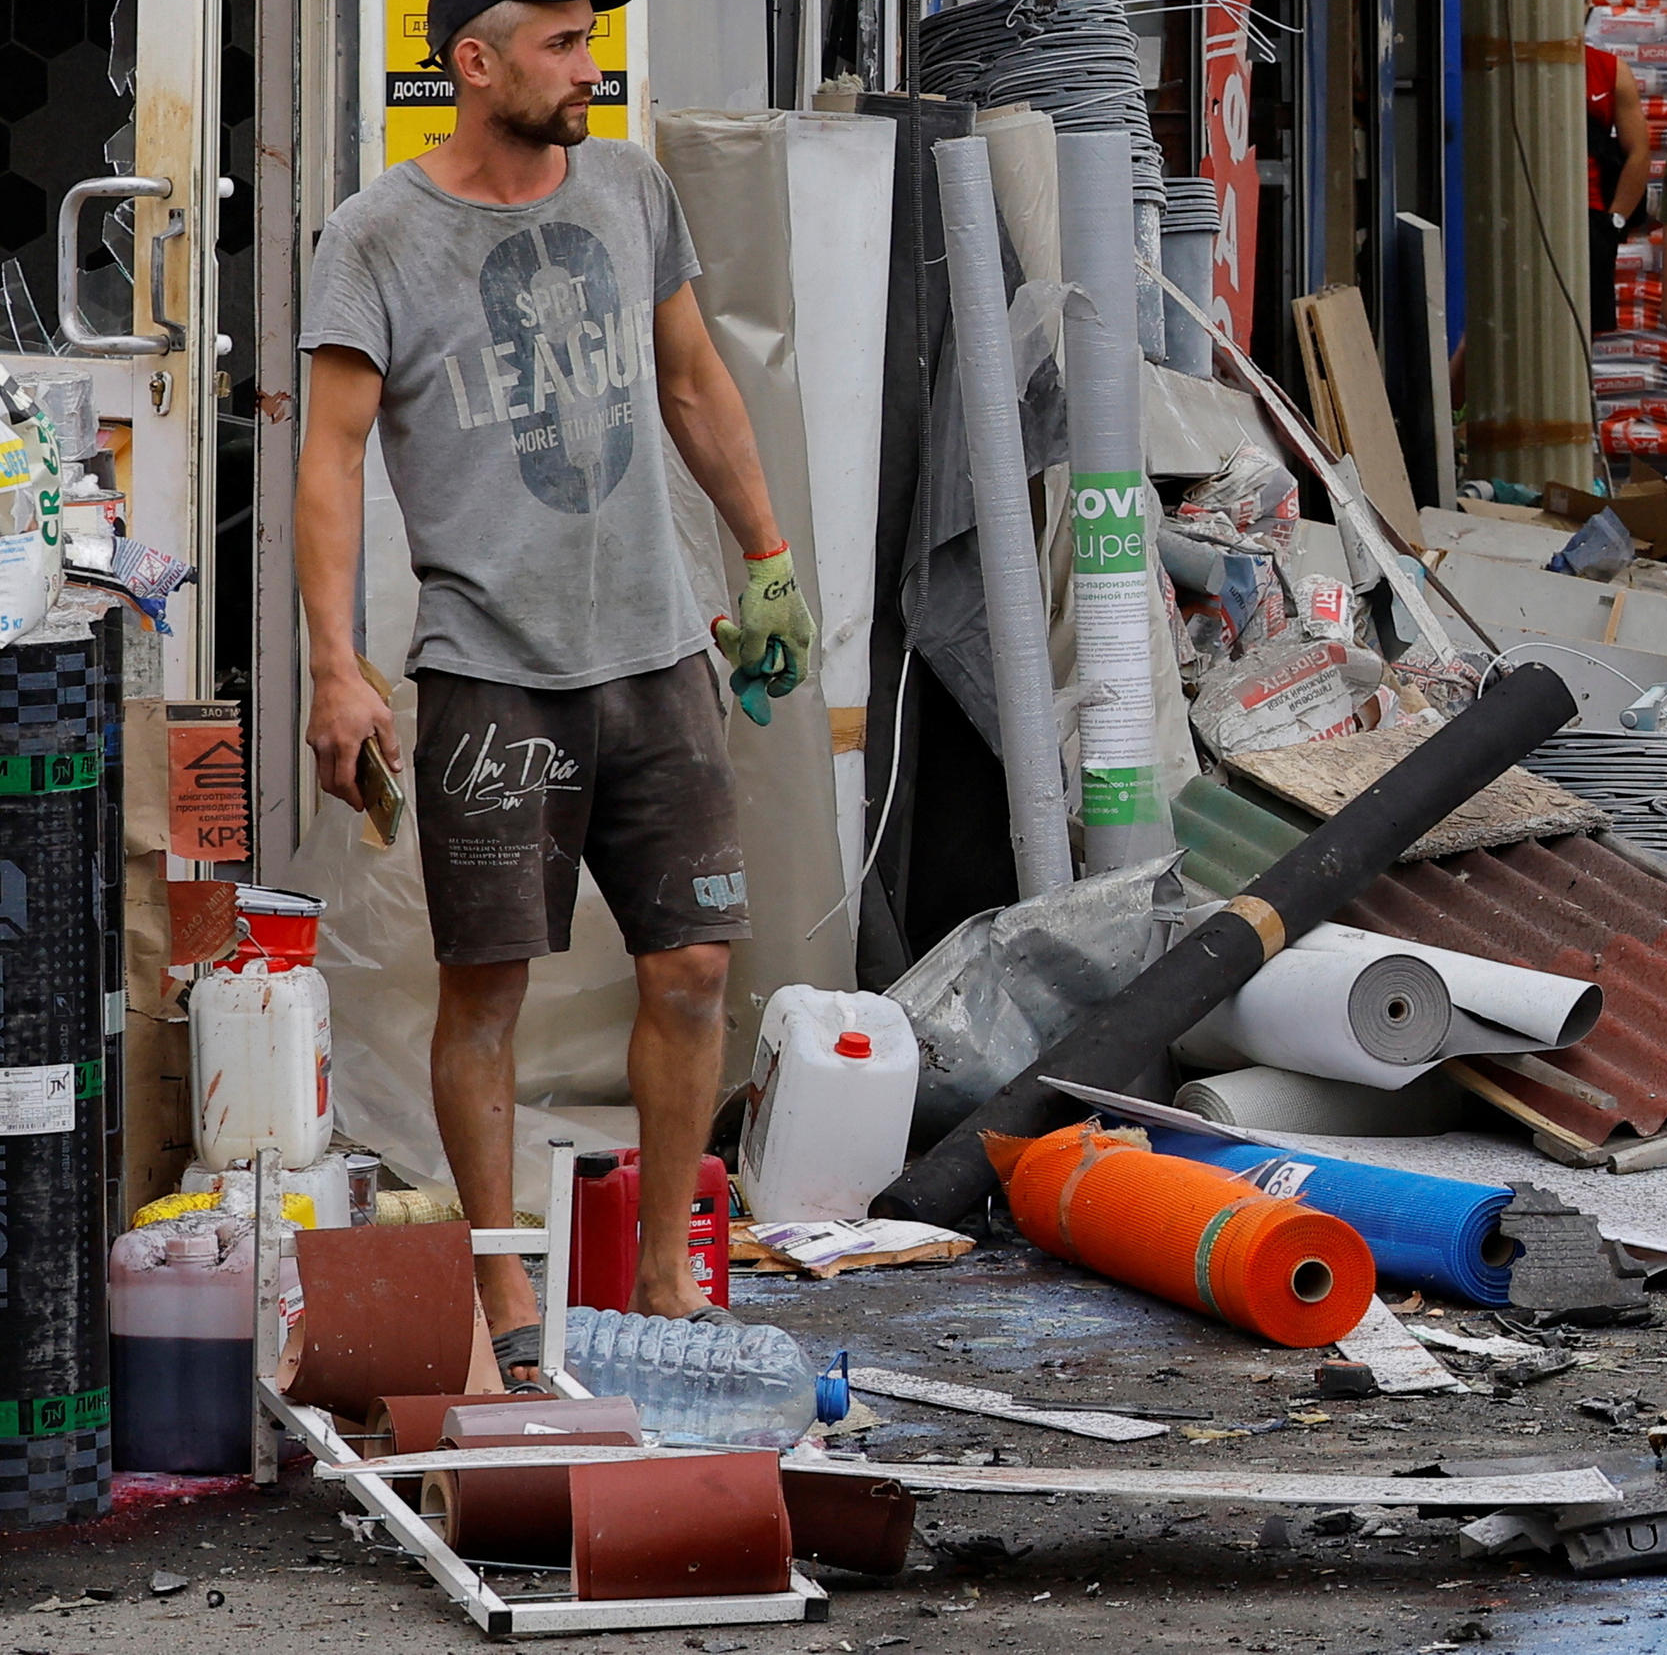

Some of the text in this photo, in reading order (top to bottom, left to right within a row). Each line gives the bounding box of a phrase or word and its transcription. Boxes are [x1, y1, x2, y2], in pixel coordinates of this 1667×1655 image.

[444, 299, 655, 430] LEAGUE
[510, 424, 560, 456] MORE
[603, 401, 634, 430] LIFE
[200, 707, 223, 718] ЗАО
